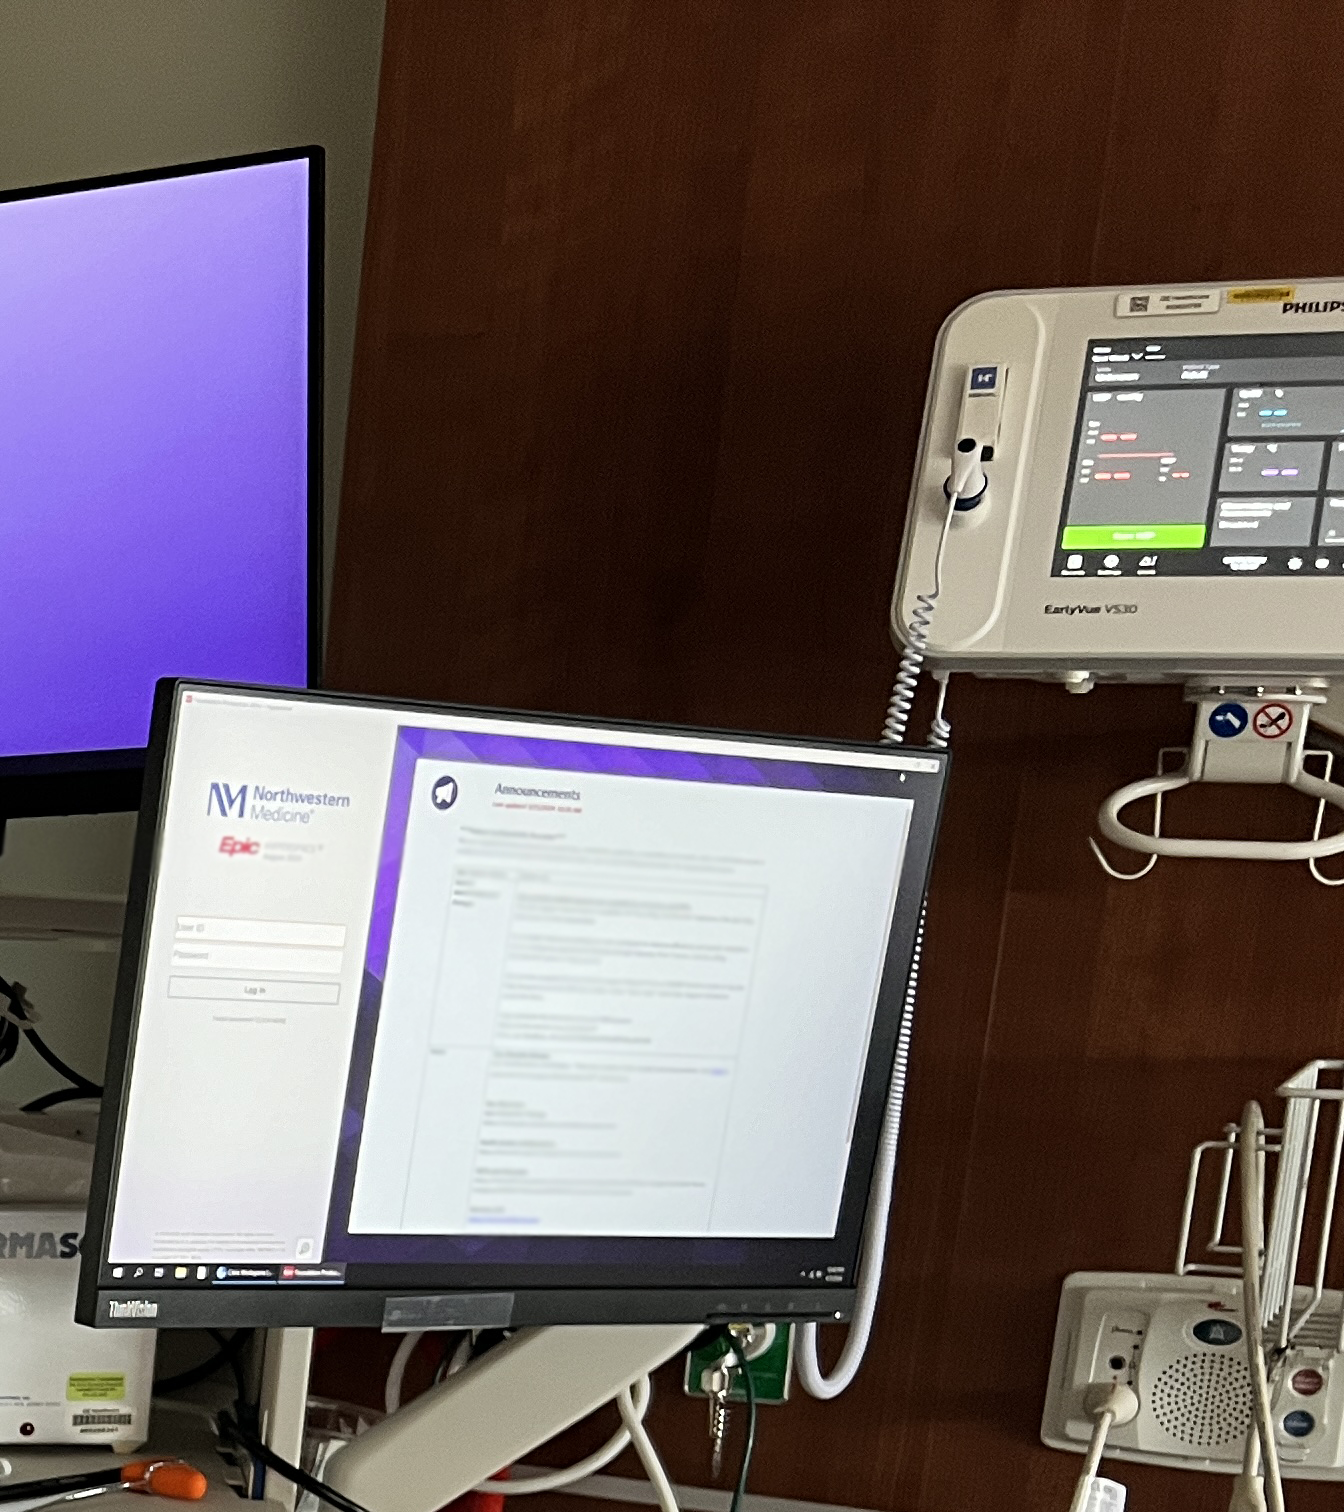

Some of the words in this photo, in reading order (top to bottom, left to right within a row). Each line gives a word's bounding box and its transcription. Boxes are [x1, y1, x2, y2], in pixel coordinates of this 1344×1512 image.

[207, 782, 248, 818] NM
[253, 785, 350, 807] Northwestern
[494, 783, 580, 800] Announcements
[250, 805, 311, 823] Medicine
[218, 836, 260, 856] Epic
[109, 1300, 158, 1318] ThinkVision
